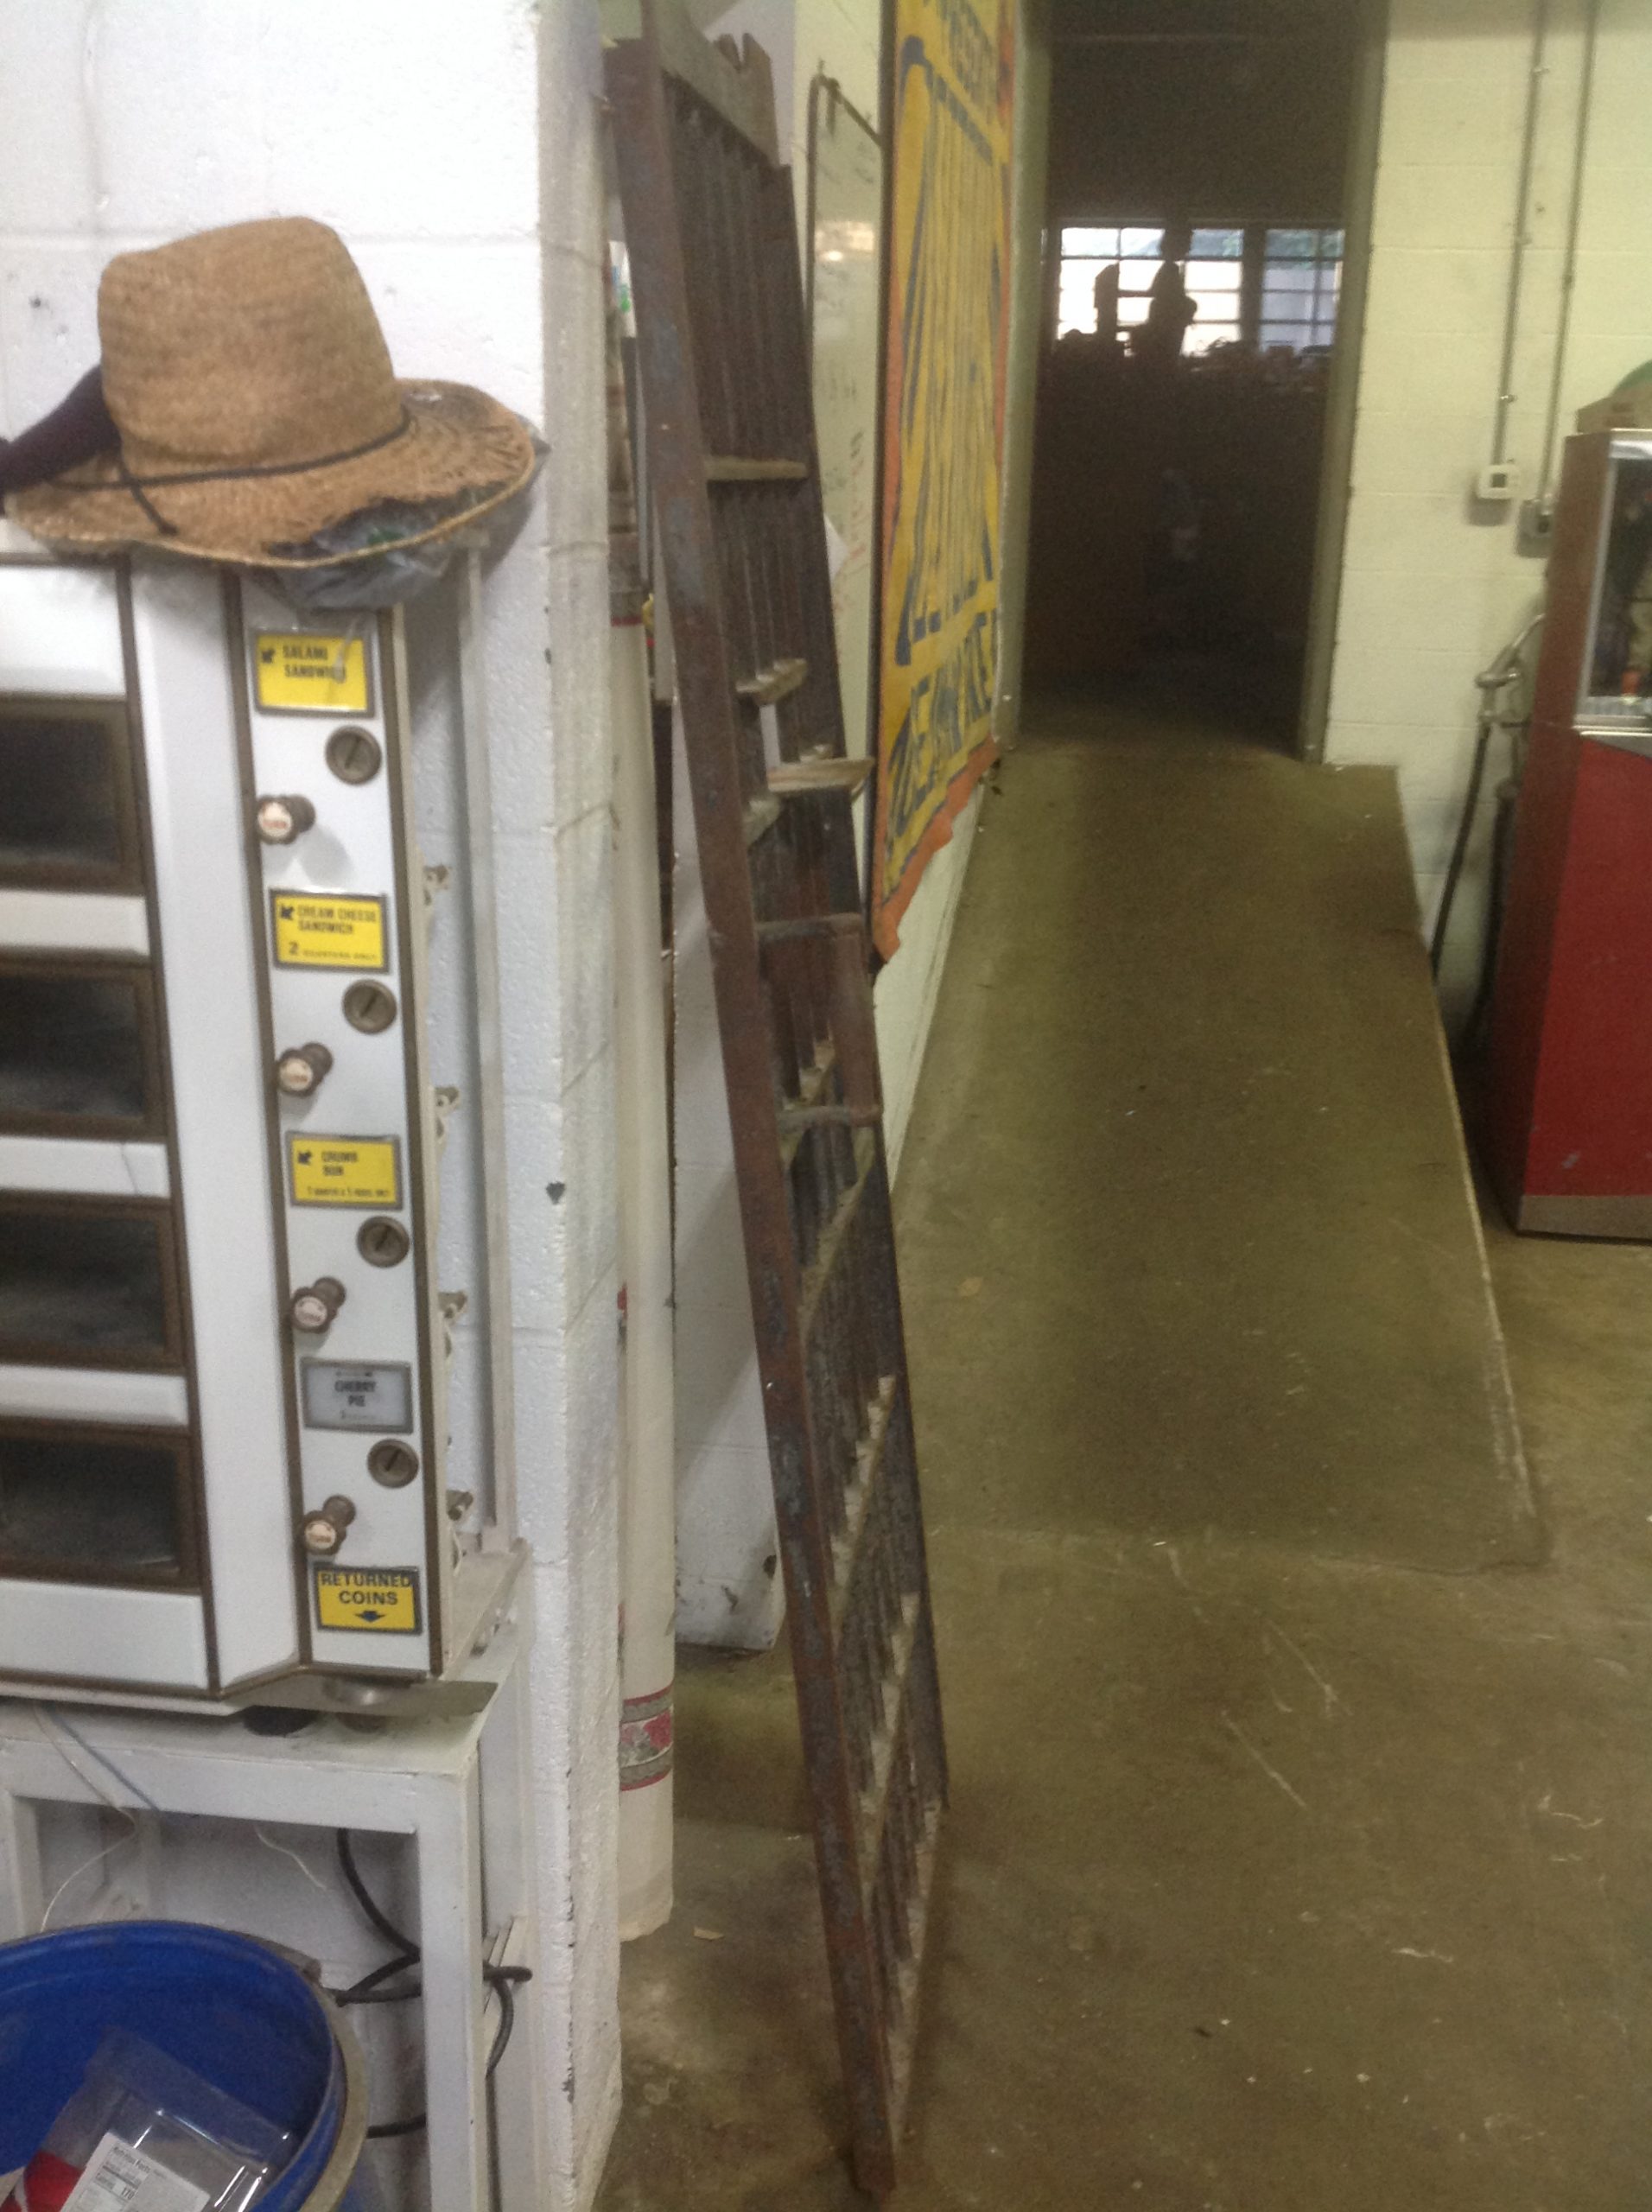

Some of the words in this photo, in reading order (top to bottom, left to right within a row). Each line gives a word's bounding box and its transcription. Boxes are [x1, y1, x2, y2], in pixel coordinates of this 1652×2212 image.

[284, 664, 346, 679] SANDWI
[289, 941, 299, 956] 2
[321, 1572, 411, 1588] RETURNED
[338, 1590, 399, 1605] COINS
